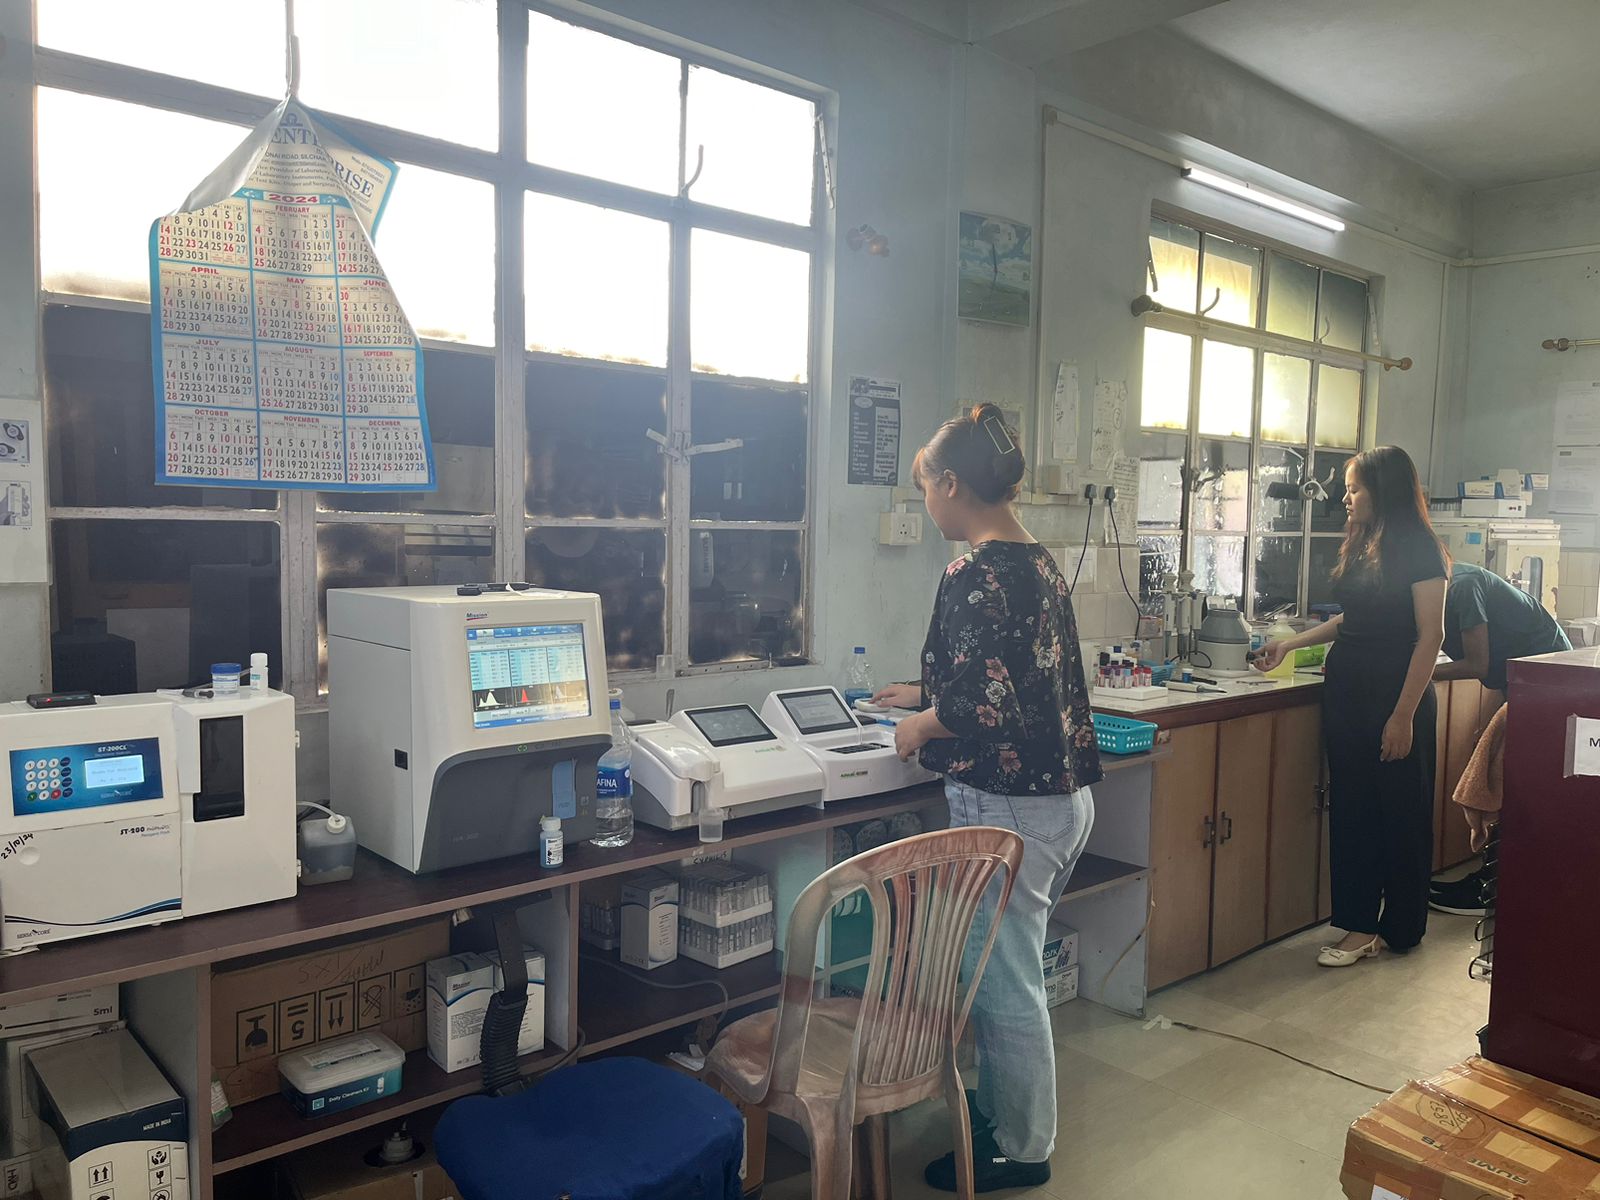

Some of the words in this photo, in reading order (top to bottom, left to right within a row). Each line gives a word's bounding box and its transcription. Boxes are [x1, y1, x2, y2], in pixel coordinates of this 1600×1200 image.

[268, 193, 318, 204] 2024
[237, 212, 242, 220] 6
[175, 216, 180, 224] 8
[199, 219, 208, 227] 10
[212, 220, 219, 229] 11
[224, 221, 233, 230] 12
[313, 220, 318, 228] 2
[323, 220, 327, 228] 3
[161, 224, 170, 234] 14
[174, 227, 182, 235] 15
[187, 228, 196, 237] 16
[199, 230, 208, 238] 17
[212, 231, 221, 240] 18
[224, 233, 233, 241] 19
[236, 234, 245, 243] 20
[268, 227, 272, 235] 5
[280, 229, 285, 237] 6
[304, 231, 308, 239] 8
[314, 231, 318, 239] 9
[160, 236, 169, 245] 21
[173, 238, 183, 247] 22
[186, 239, 196, 248] 23
[199, 241, 209, 250] 24
[212, 242, 221, 250] 25
[224, 243, 233, 252] 26
[255, 236, 262, 245] 11
[267, 238, 276, 246] 12
[279, 240, 287, 248] 13
[291, 241, 299, 249] 14
[303, 242, 310, 250] 15
[314, 242, 321, 250] 16
[323, 242, 330, 250] 17
[161, 247, 171, 256] 28
[173, 249, 183, 258] 29
[186, 251, 196, 259] 30
[198, 252, 208, 261] 31
[255, 247, 264, 256] 18
[268, 248, 276, 257] 19
[291, 252, 299, 260] 21
[302, 253, 311, 261] 22
[314, 253, 322, 262] 23
[255, 258, 264, 266] 25
[267, 260, 276, 268] 26
[279, 261, 288, 269] 27
[291, 263, 300, 271] 28
[303, 264, 312, 272] 29
[198, 422, 200, 430] 1
[210, 423, 214, 431] 2
[222, 424, 227, 432] 3
[170, 431, 175, 440] 6
[184, 432, 189, 440] 7
[197, 433, 201, 441] 8
[210, 434, 214, 442] 9
[221, 434, 230, 442] 10
[234, 436, 241, 444] 11
[374, 432, 377, 440] 3
[395, 432, 399, 440] 5
[169, 442, 178, 451] 13
[183, 443, 192, 451] 14
[195, 444, 204, 453] 15
[208, 444, 217, 453] 16
[221, 446, 230, 454] 17
[234, 447, 242, 455] 18
[168, 453, 178, 462] 20
[182, 454, 191, 463] 21
[195, 456, 204, 464] 22
[207, 456, 217, 464] 23
[220, 457, 230, 465] 24
[362, 452, 369, 461] 16
[168, 464, 178, 472] 27
[182, 465, 192, 473] 28
[194, 467, 204, 475] 29
[207, 467, 217, 476] 30
[94, 1006, 113, 1016] 5ml
